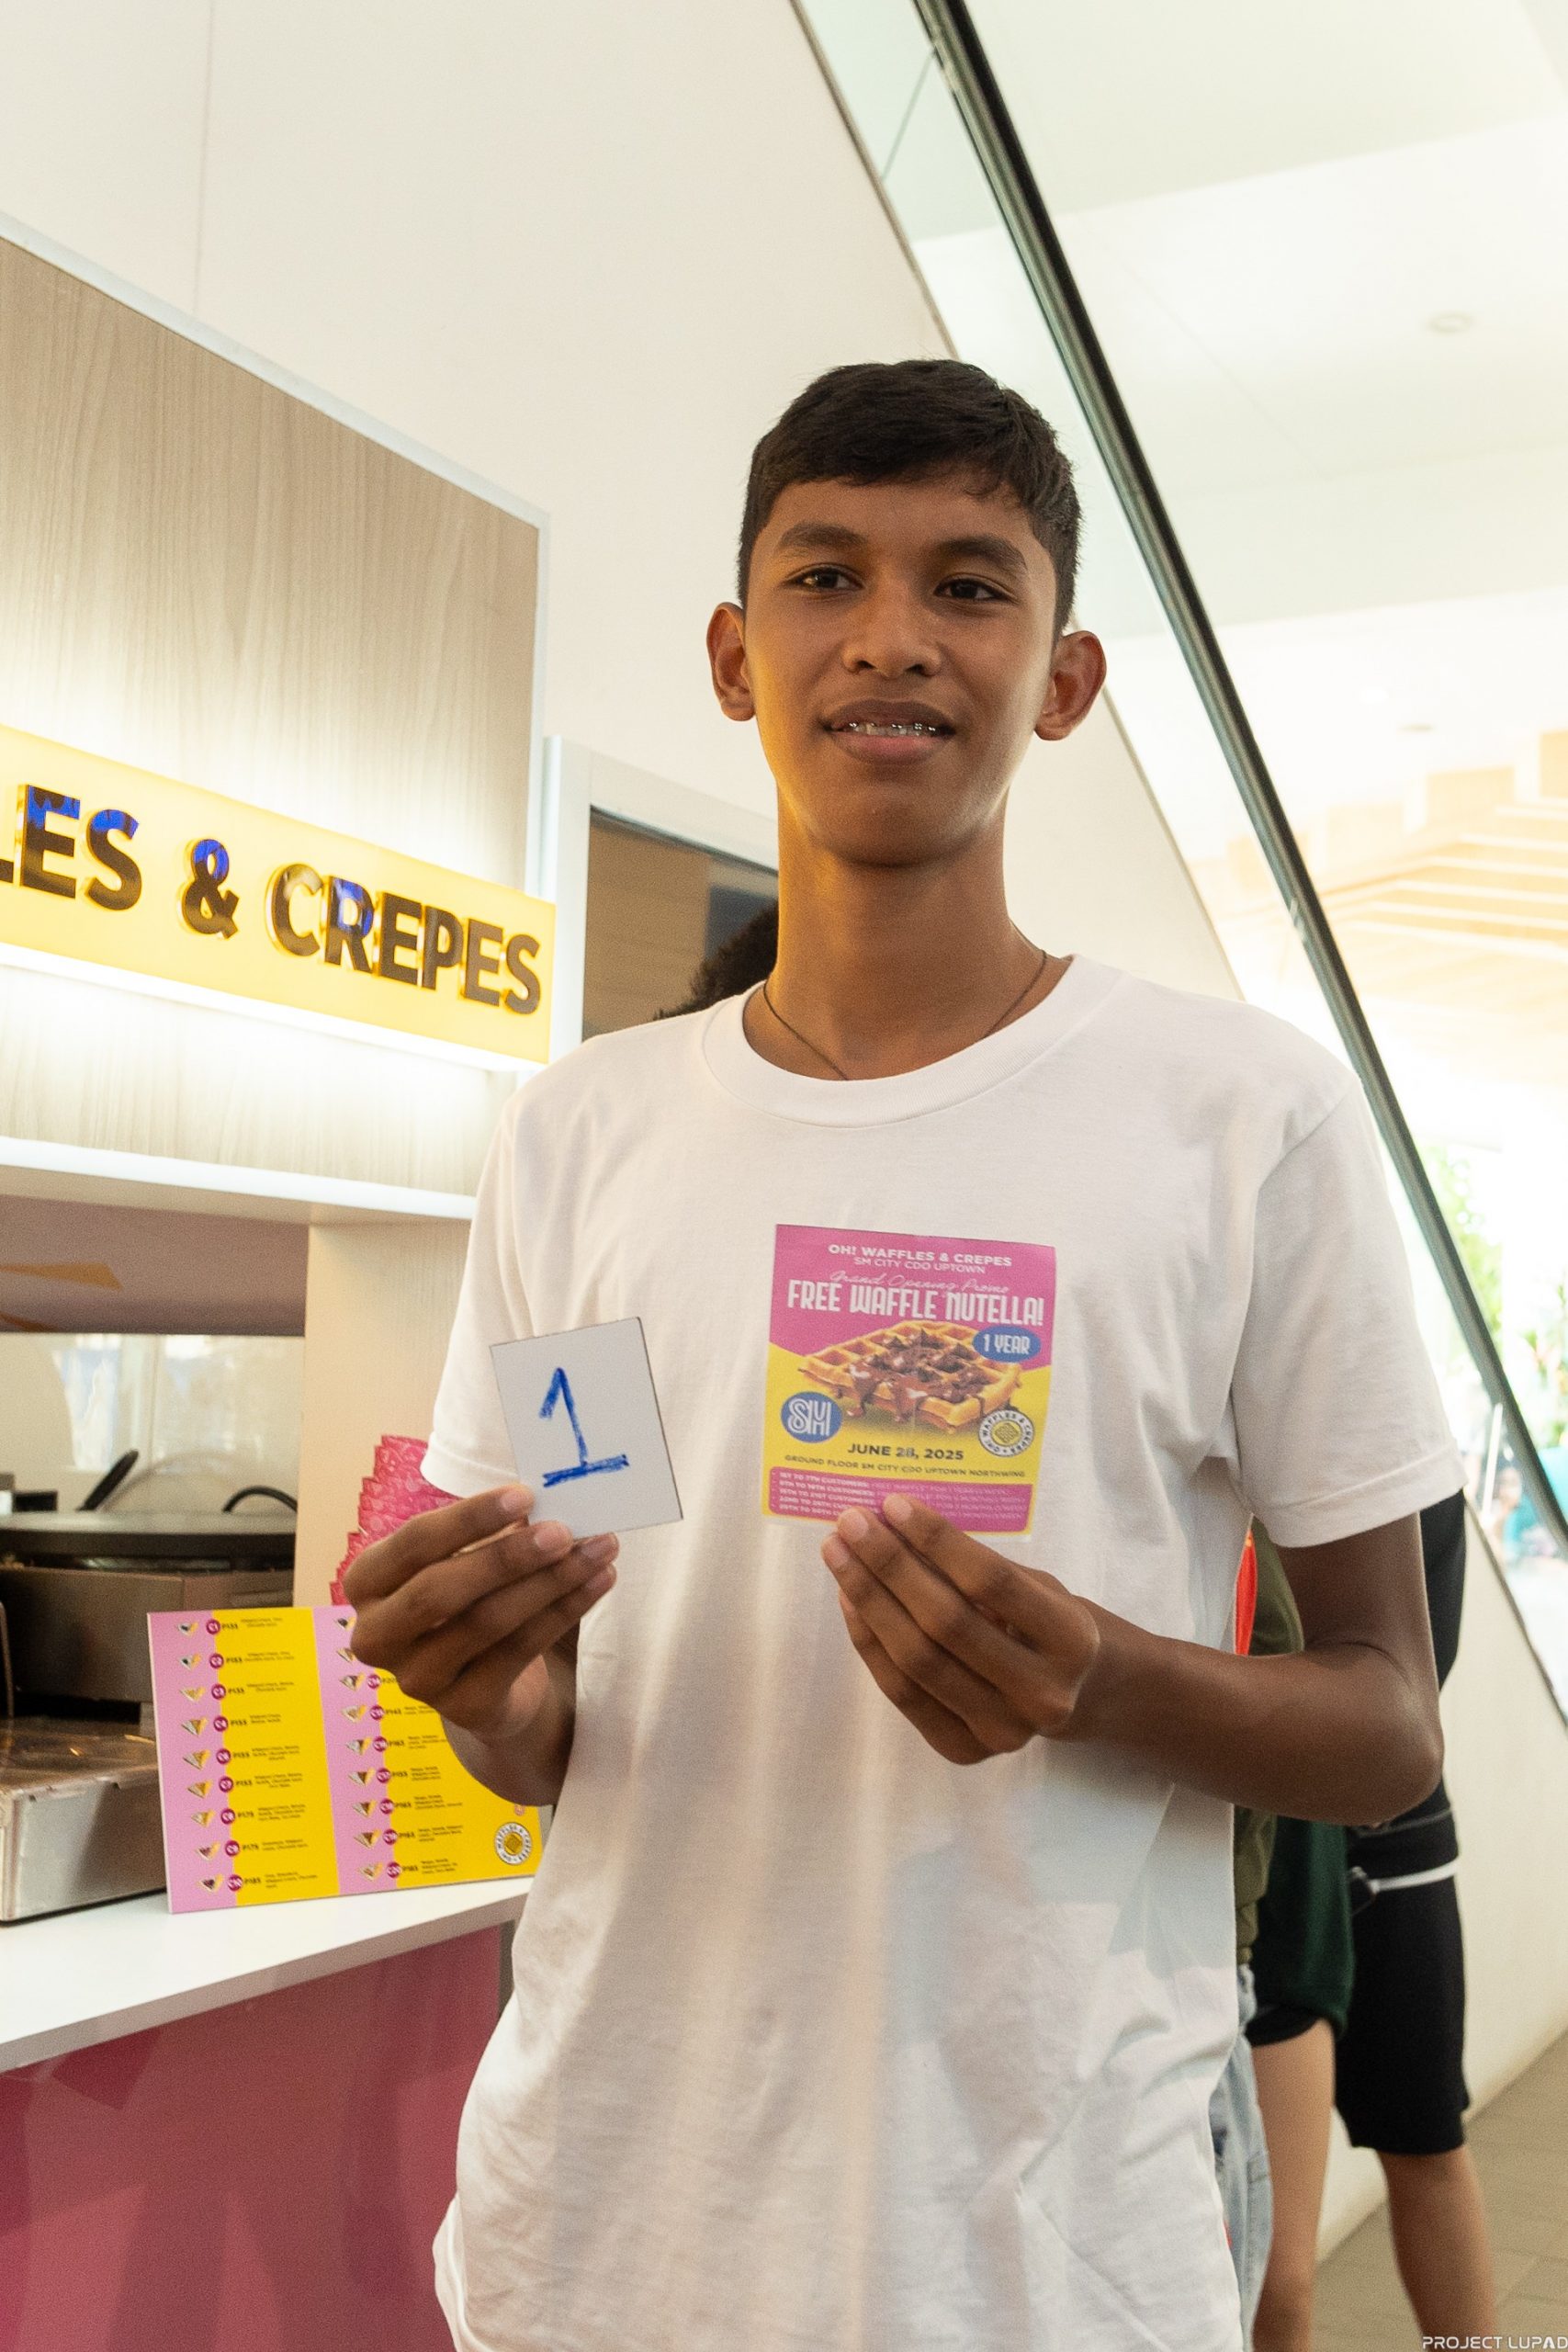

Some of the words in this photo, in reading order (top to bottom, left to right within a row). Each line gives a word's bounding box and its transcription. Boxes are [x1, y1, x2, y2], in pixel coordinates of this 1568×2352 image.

[0, 784, 142, 911] ES
[178, 838, 240, 940] &
[265, 863, 543, 1016] CREPES
[829, 1243, 858, 1256] OH!
[861, 1246, 935, 1262] WAFFLES
[940, 1251, 950, 1262] &
[953, 1252, 1013, 1268] CREPES
[854, 1256, 872, 1266] SM
[874, 1258, 902, 1269] CITY
[904, 1261, 931, 1271] CDO
[932, 1262, 987, 1274] UPTOWN
[787, 1279, 843, 1313] FREE
[849, 1283, 939, 1320] WAFFLE
[945, 1291, 1045, 1327] NUTELLA!
[983, 1334, 990, 1352] 1
[994, 1334, 1031, 1356] YEAR
[538, 1366, 630, 1488] 1
[787, 1397, 832, 1437] SM
[784, 1454, 825, 1465] GROUND
[828, 1459, 859, 1469] FLOOR
[847, 1443, 892, 1456] JUNE
[923, 1448, 964, 1460] 2025
